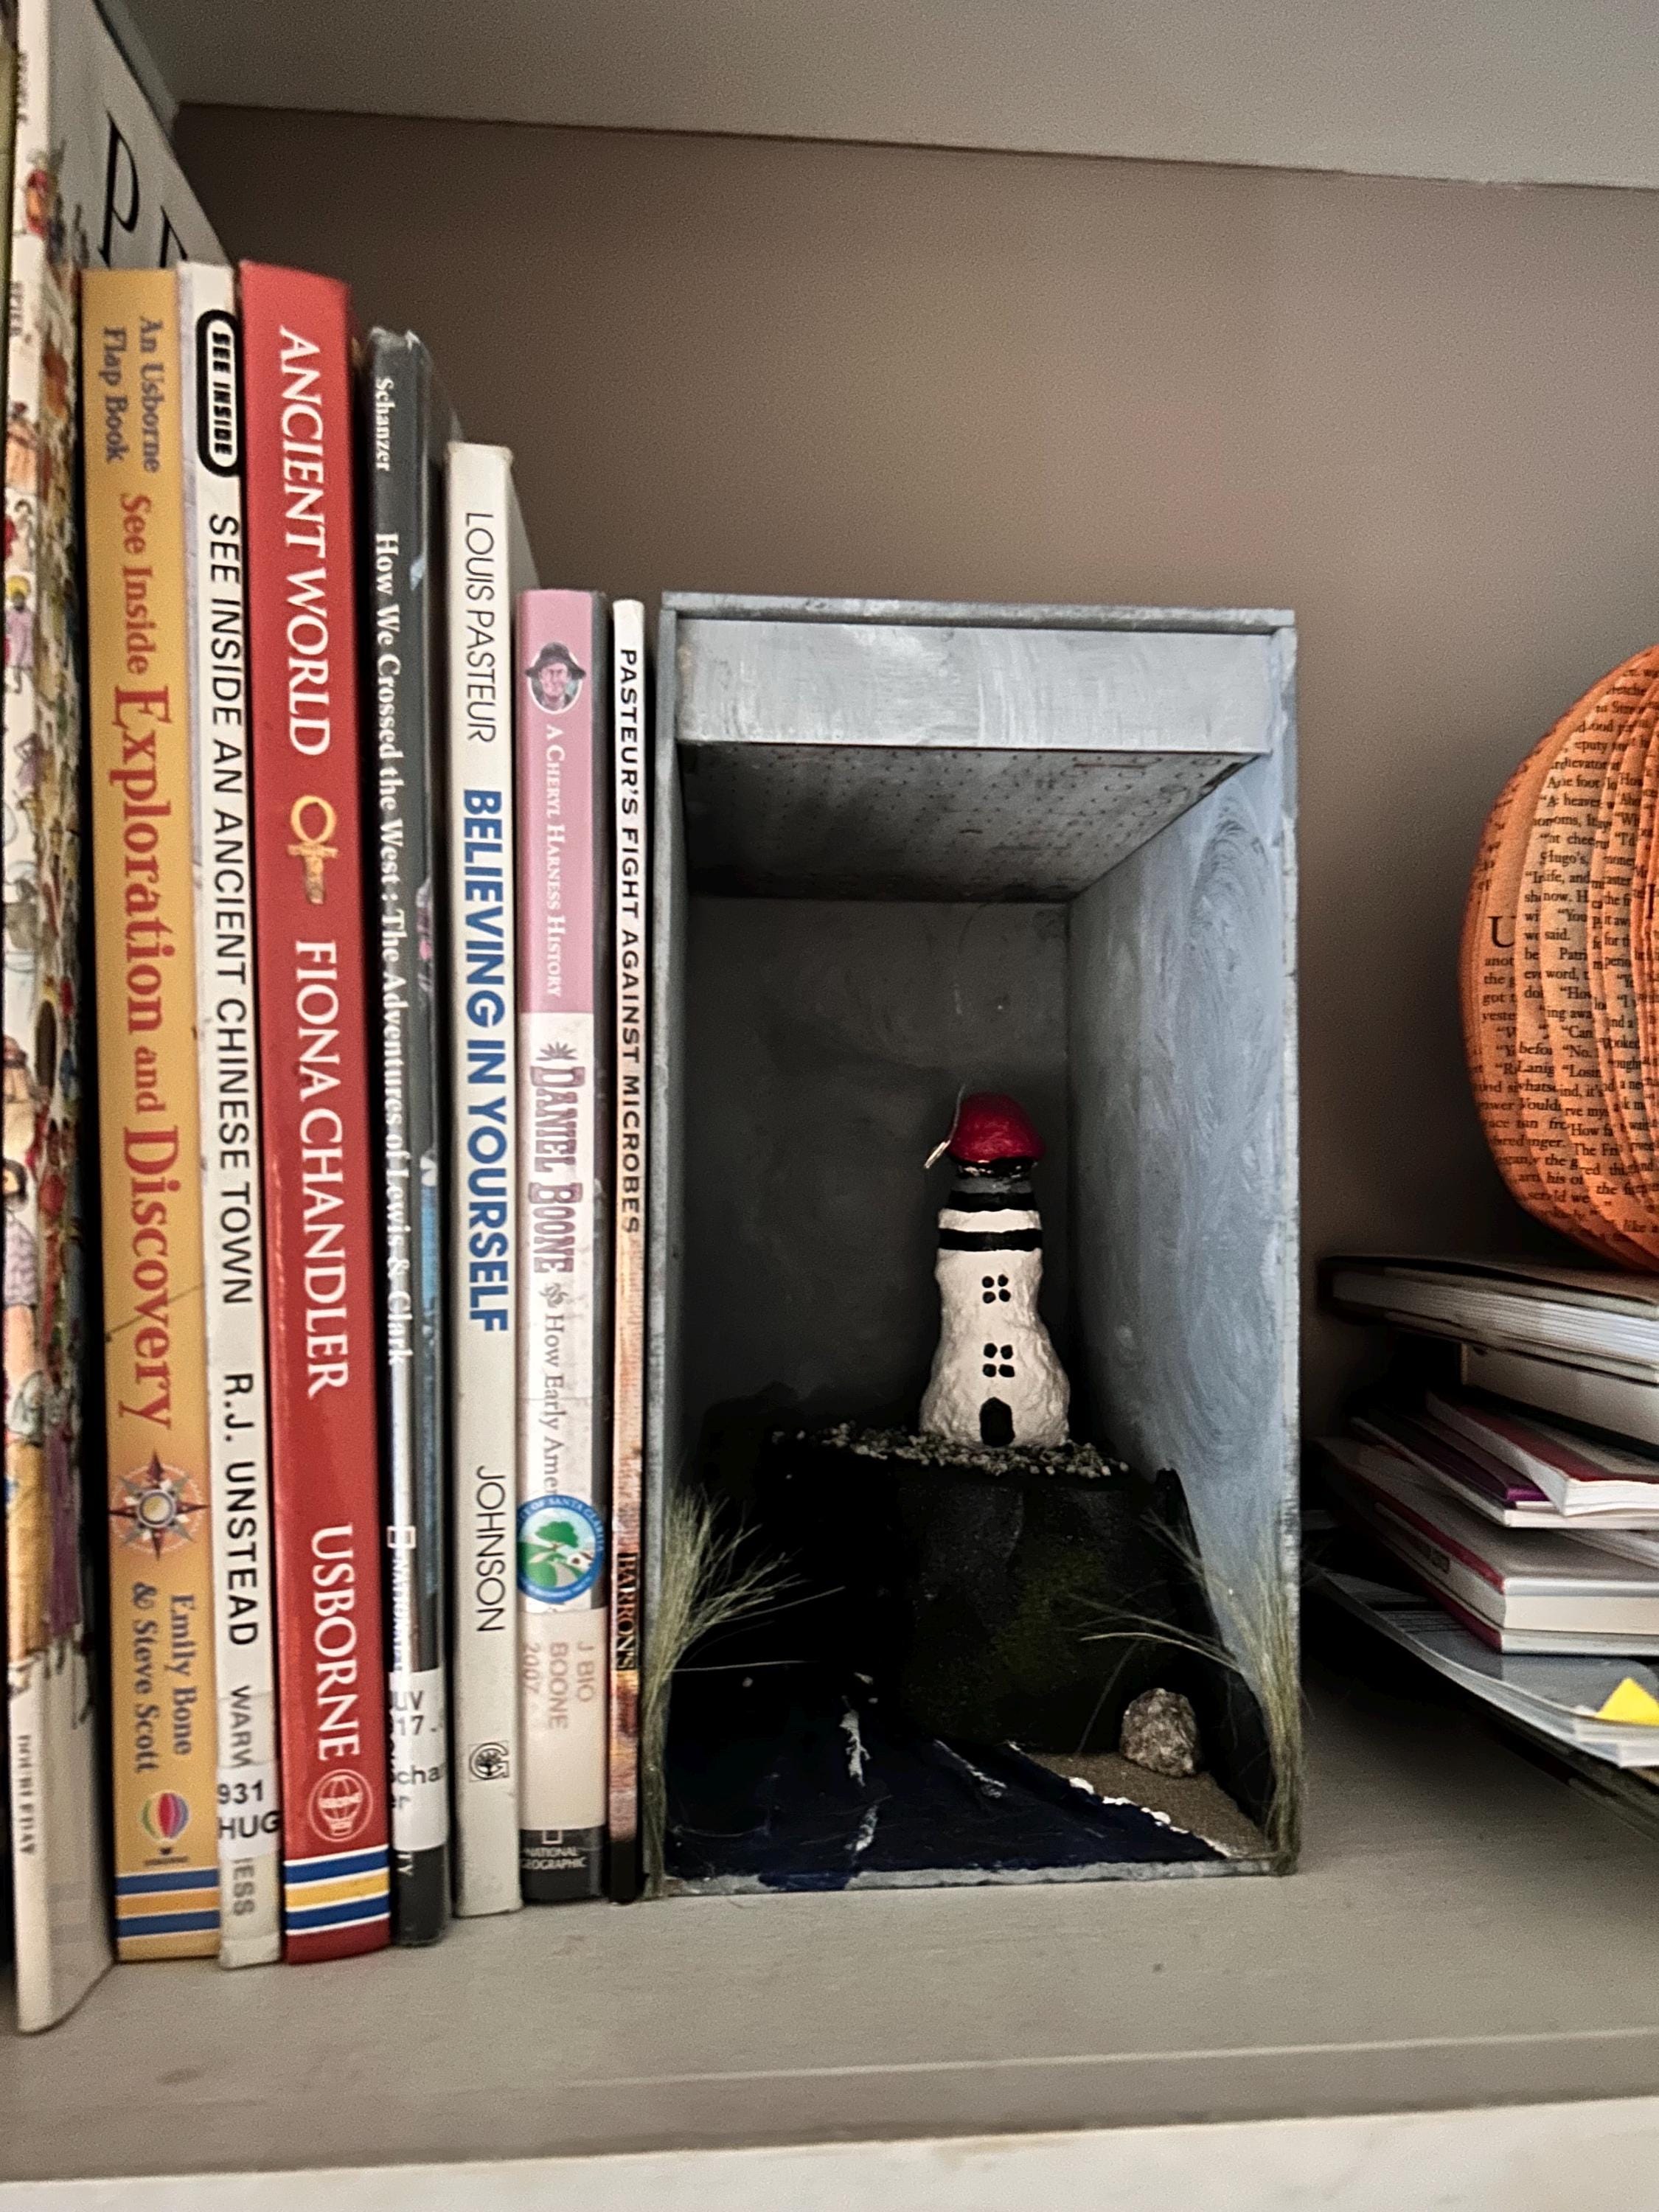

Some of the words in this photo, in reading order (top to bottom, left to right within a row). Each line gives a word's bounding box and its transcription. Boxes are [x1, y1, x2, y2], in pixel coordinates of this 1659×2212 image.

[99, 327, 128, 386] Flap
[139, 317, 163, 353] An
[212, 332, 232, 374] SEE
[105, 395, 131, 463] Book
[140, 363, 165, 473] Usborne
[212, 381, 233, 456] INSIDE
[279, 325, 326, 558] ANCIENT
[375, 375, 397, 473] Schanzer
[119, 493, 153, 554] See
[209, 514, 240, 584] SEE
[465, 512, 495, 602] LOUIS
[375, 532, 400, 597] How
[122, 566, 157, 675] Inside
[377, 603, 401, 647] We
[211, 598, 243, 727] INSIDE
[286, 567, 331, 757] WORLD
[467, 610, 497, 744] PASTEUR
[377, 653, 406, 759] Crossed
[546, 723, 563, 740] A
[620, 649, 639, 815] PASTEUR'S
[213, 739, 244, 795] AN
[378, 766, 406, 810] the
[546, 744, 566, 818] CHERYL
[108, 684, 176, 1035] Exploration
[379, 818, 404, 885] West
[546, 824, 566, 911] HARNESS
[621, 827, 639, 919] FIGHT
[213, 808, 246, 986] ANCIENT
[380, 908, 408, 963] The
[464, 789, 506, 1029] BELIEVING
[546, 915, 566, 997] HISTORY
[296, 939, 341, 1102] FIONA
[622, 929, 641, 1064] AGAINST
[134, 1046, 168, 1115] and
[216, 998, 250, 1170] CHINESE
[383, 970, 410, 1126] Adventures
[467, 1040, 507, 1085] IN
[385, 1133, 413, 1161] of
[529, 1065, 587, 1173] DANIEL
[622, 1074, 641, 1234] MICROBES
[220, 1180, 253, 1304] TOWN
[385, 1168, 413, 1247] Lewis
[467, 1096, 509, 1332] YOURSELF
[527, 1181, 584, 1273] BOONE
[116, 1125, 181, 1430] Discovery
[299, 1107, 349, 1401] CHANDLER
[386, 1254, 411, 1281] &
[387, 1291, 414, 1366] Clark
[544, 1314, 565, 1368] How
[223, 1373, 256, 1442] R.J.
[538, 1373, 568, 1430] Early
[225, 1461, 259, 1646] UNSTEAD
[476, 1465, 506, 1632] JOHNSON
[133, 1582, 159, 1610] &
[164, 1593, 198, 1677] Emily
[617, 1555, 638, 1669] BARRON'S
[133, 1619, 160, 1694] Steve
[310, 1523, 361, 1761] USBORNE
[522, 1641, 541, 1694] 2007
[577, 1641, 594, 1652] J
[577, 1660, 597, 1703] BIO
[172, 1687, 199, 1756] Bone
[548, 1641, 569, 1730] BOONE
[134, 1704, 161, 1774] Scott
[217, 1780, 263, 1804] 931
[233, 1858, 255, 1916] ESS
